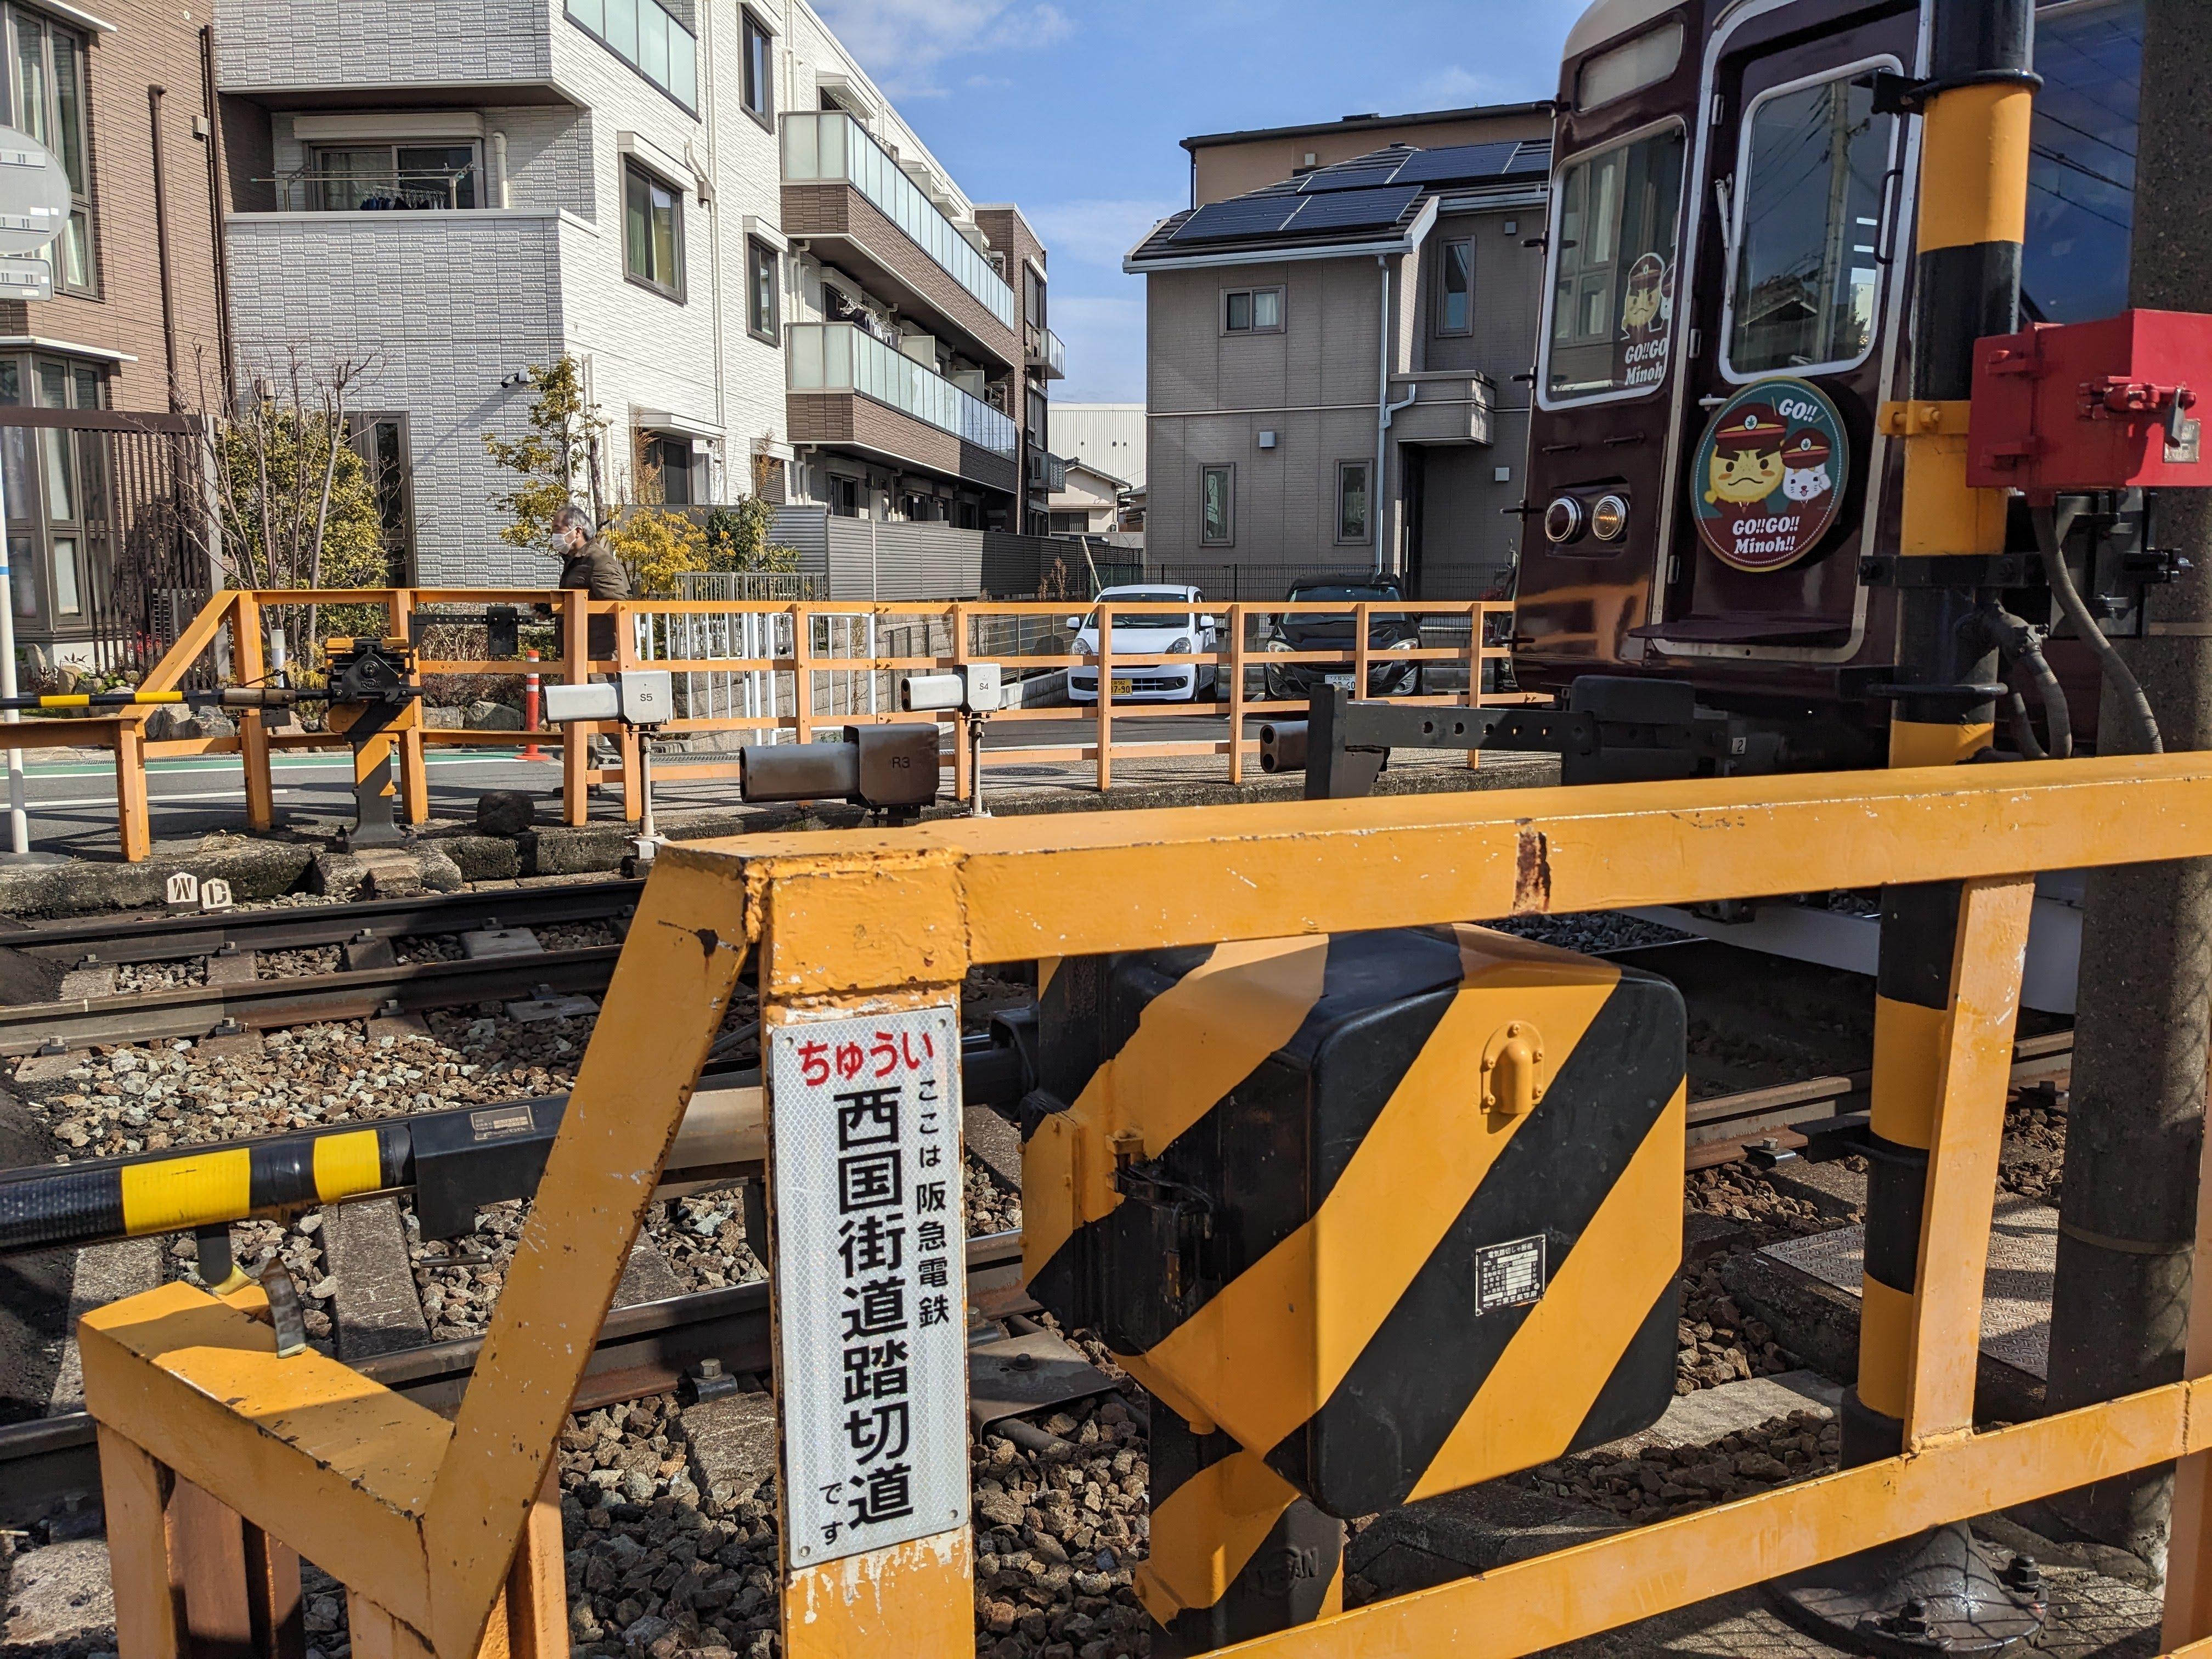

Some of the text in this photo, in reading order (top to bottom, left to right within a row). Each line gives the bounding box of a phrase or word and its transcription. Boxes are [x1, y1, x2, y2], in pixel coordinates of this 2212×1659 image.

[1779, 399, 1818, 422] GO!!
[1733, 516, 1800, 535] GO!!GO!!
[1734, 536, 1796, 554] Minoh!!
[1737, 740, 1743, 752] 2
[892, 757, 910, 769] R3
[798, 1031, 934, 1086] ちゅうい
[833, 1086, 914, 1530] 西国街道踏切道
[820, 1482, 844, 1545] です
